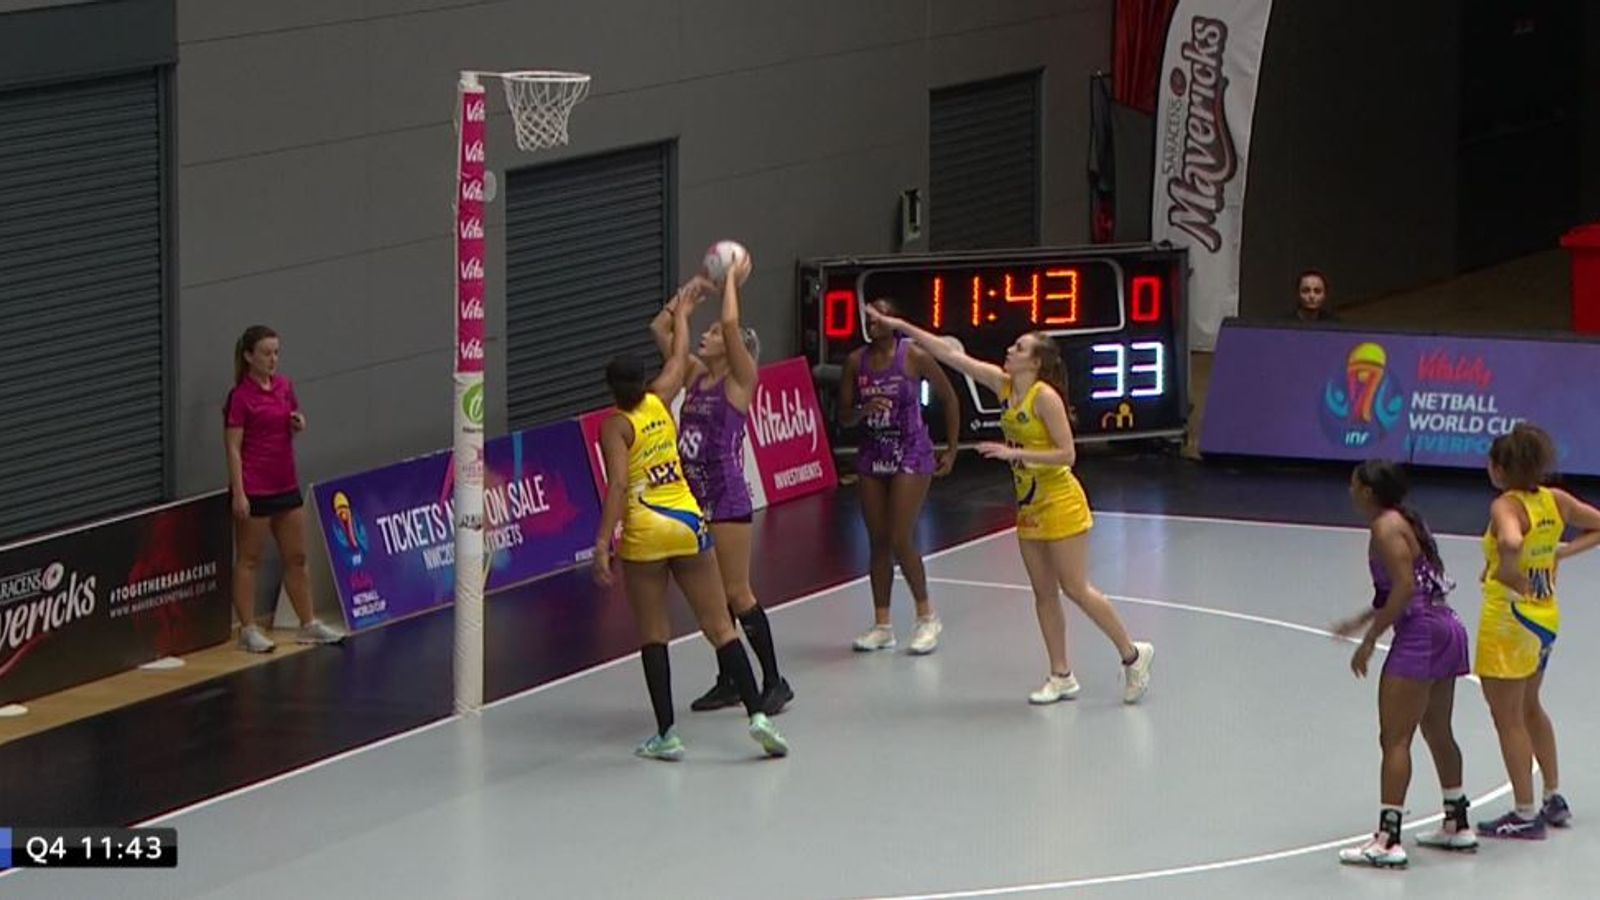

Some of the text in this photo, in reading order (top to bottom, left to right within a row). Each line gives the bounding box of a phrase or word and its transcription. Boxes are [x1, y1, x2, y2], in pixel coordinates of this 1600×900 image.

[1162, 96, 1184, 177] SARACENS
[1167, 15, 1228, 253] Mavericks
[825, 290, 856, 339] 0
[932, 268, 1081, 329] 11:43
[1132, 276, 1162, 322] 0
[1092, 341, 1165, 399] 33
[1417, 348, 1494, 390] Vitality
[750, 383, 818, 453] Vitality
[1408, 412, 1526, 435] WORLD CU
[1411, 391, 1498, 414] NETBALL
[1404, 432, 1493, 456] LIVERPO
[376, 505, 446, 554] TICKETS
[484, 485, 509, 522] ON
[508, 474, 551, 517] SALE
[110, 561, 217, 603] #TOGETHERSARACENS
